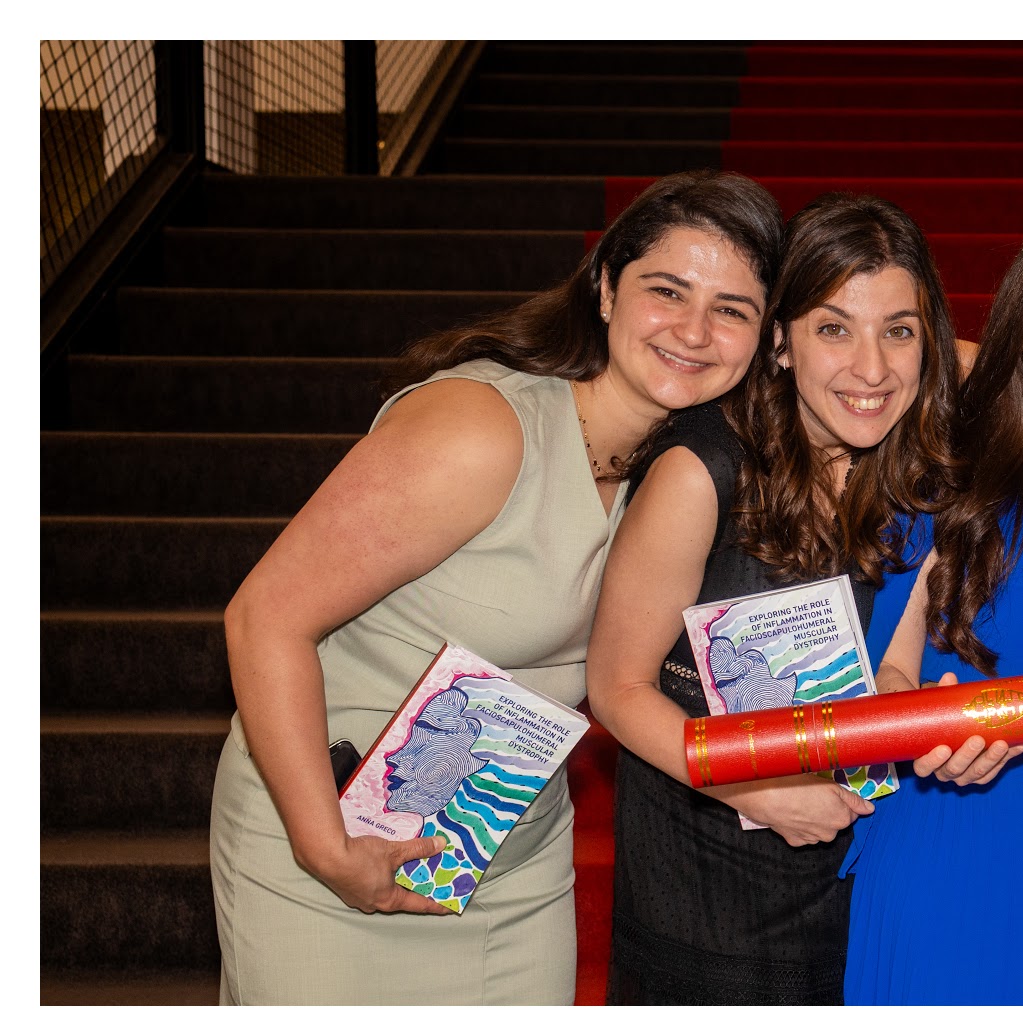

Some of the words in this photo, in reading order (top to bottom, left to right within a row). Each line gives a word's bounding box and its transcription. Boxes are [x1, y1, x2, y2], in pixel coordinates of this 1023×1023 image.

[748, 607, 792, 623] EXPLORING
[792, 603, 809, 613] THE
[810, 598, 831, 610] ROLE
[751, 624, 762, 632] OF
[763, 610, 822, 630] INFLAMMATION
[823, 607, 833, 615] IN
[740, 616, 836, 643] FACIOSCAPULOHUMERAL
[793, 624, 838, 641] MUSCULAR
[793, 633, 840, 651] DYSTROPHY
[475, 703, 558, 751] FACIOSCAPULOHUMERAL
[493, 703, 504, 711] OF
[504, 708, 556, 739] INFLAMMATION
[555, 735, 566, 744] IN
[498, 695, 538, 719] EXPLORING
[538, 715, 552, 727] THE
[551, 723, 571, 737] ROLE
[507, 740, 549, 765] DYSTROPHY
[515, 734, 555, 758] MUSCULAR
[356, 815, 375, 827] ANNA
[375, 822, 397, 836] GRECO
